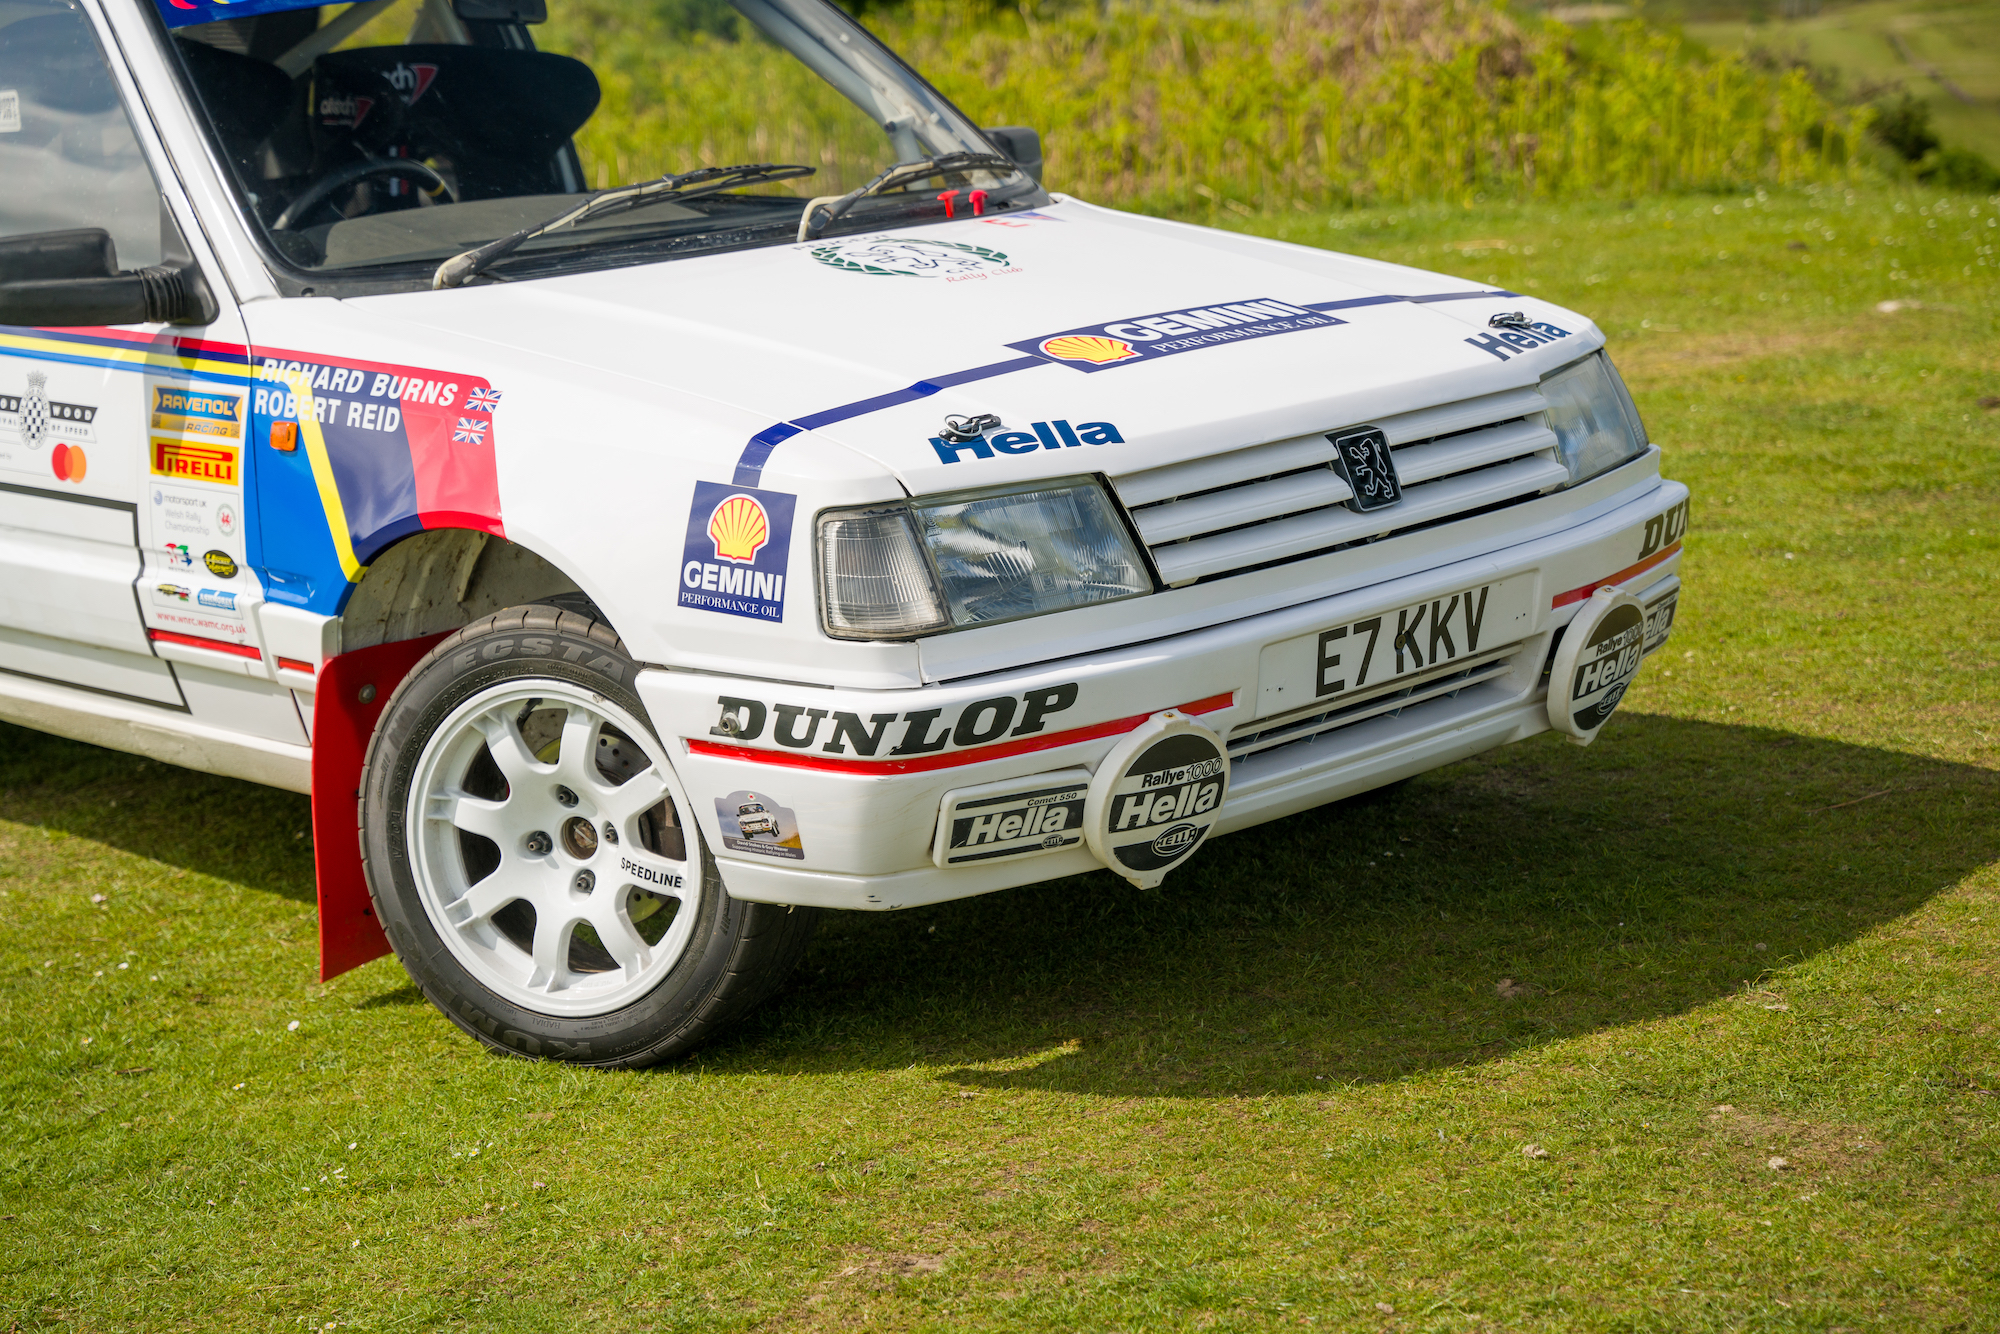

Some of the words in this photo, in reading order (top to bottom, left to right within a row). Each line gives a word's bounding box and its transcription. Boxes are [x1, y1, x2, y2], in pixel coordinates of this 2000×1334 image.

[946, 272, 988, 283] Rally
[991, 266, 1024, 276] Club
[1103, 300, 1310, 341] GEMINI
[1149, 320, 1296, 353] PERFORMANCE
[1296, 315, 1336, 327] OIL
[1464, 321, 1573, 362] Hella
[259, 358, 364, 394] RICHARD
[370, 373, 459, 407] BURNS
[52, 404, 93, 421] WOOD
[162, 393, 233, 416] RAVENOL
[254, 388, 341, 425] ROBERT
[346, 401, 401, 433] REID
[186, 422, 228, 435] RACING
[928, 419, 1126, 465] Hella
[156, 443, 233, 480] PIRELLI
[164, 495, 198, 507] motorsport
[165, 508, 184, 519] Welsh
[186, 511, 202, 524] Rally
[165, 520, 211, 536] Championship
[683, 560, 784, 603] GEMINI
[681, 591, 759, 616] PERFORMANCE
[760, 605, 780, 619] OIL
[1316, 616, 1382, 697] E7
[1394, 586, 1490, 675] KKV
[1645, 608, 1670, 641] ella
[452, 637, 626, 683] ECSTA
[1595, 637, 1623, 658] Rallye
[1578, 642, 1640, 697] Hella
[709, 682, 1079, 757] DUNLOP
[1141, 770, 1185, 789] Rallye
[1185, 757, 1223, 782] 1000
[1027, 794, 1057, 807] Comet
[1059, 791, 1078, 803] 550
[1116, 782, 1221, 830] Hella
[965, 806, 1070, 847] Hella
[1155, 828, 1199, 848] HELLA
[621, 857, 682, 888] SPEEDLINE
[395, 920, 593, 1060] KUMHO
[533, 1018, 561, 1030] RADIAL
